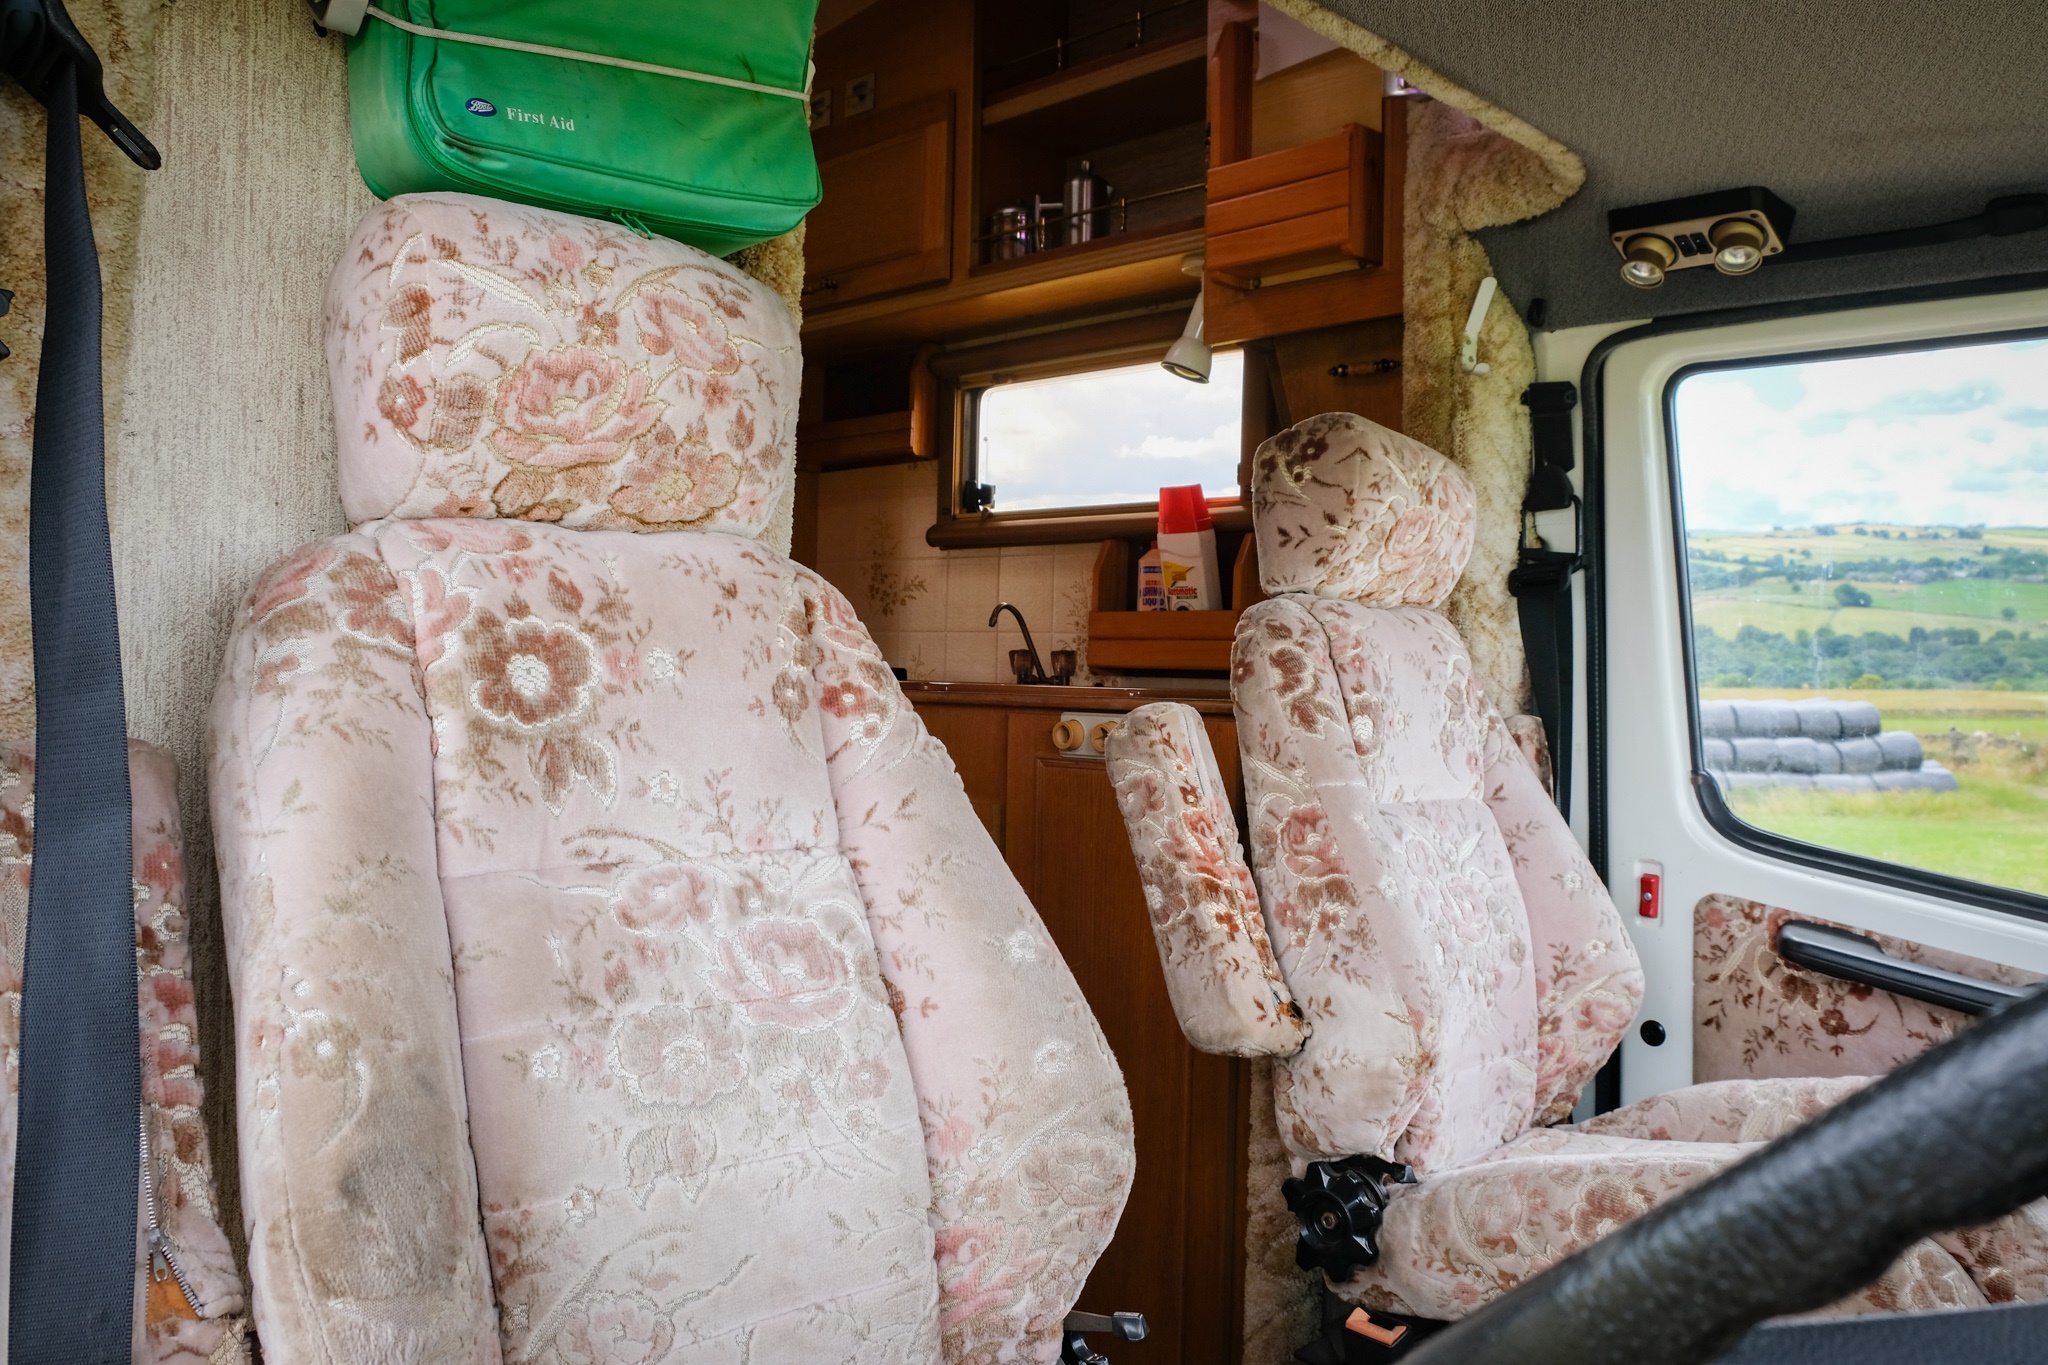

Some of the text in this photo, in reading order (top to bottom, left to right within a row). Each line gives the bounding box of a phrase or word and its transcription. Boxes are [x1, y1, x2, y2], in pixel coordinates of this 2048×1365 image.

[506, 107, 575, 131] First Aid
[1142, 597, 1165, 606] LIQUD
